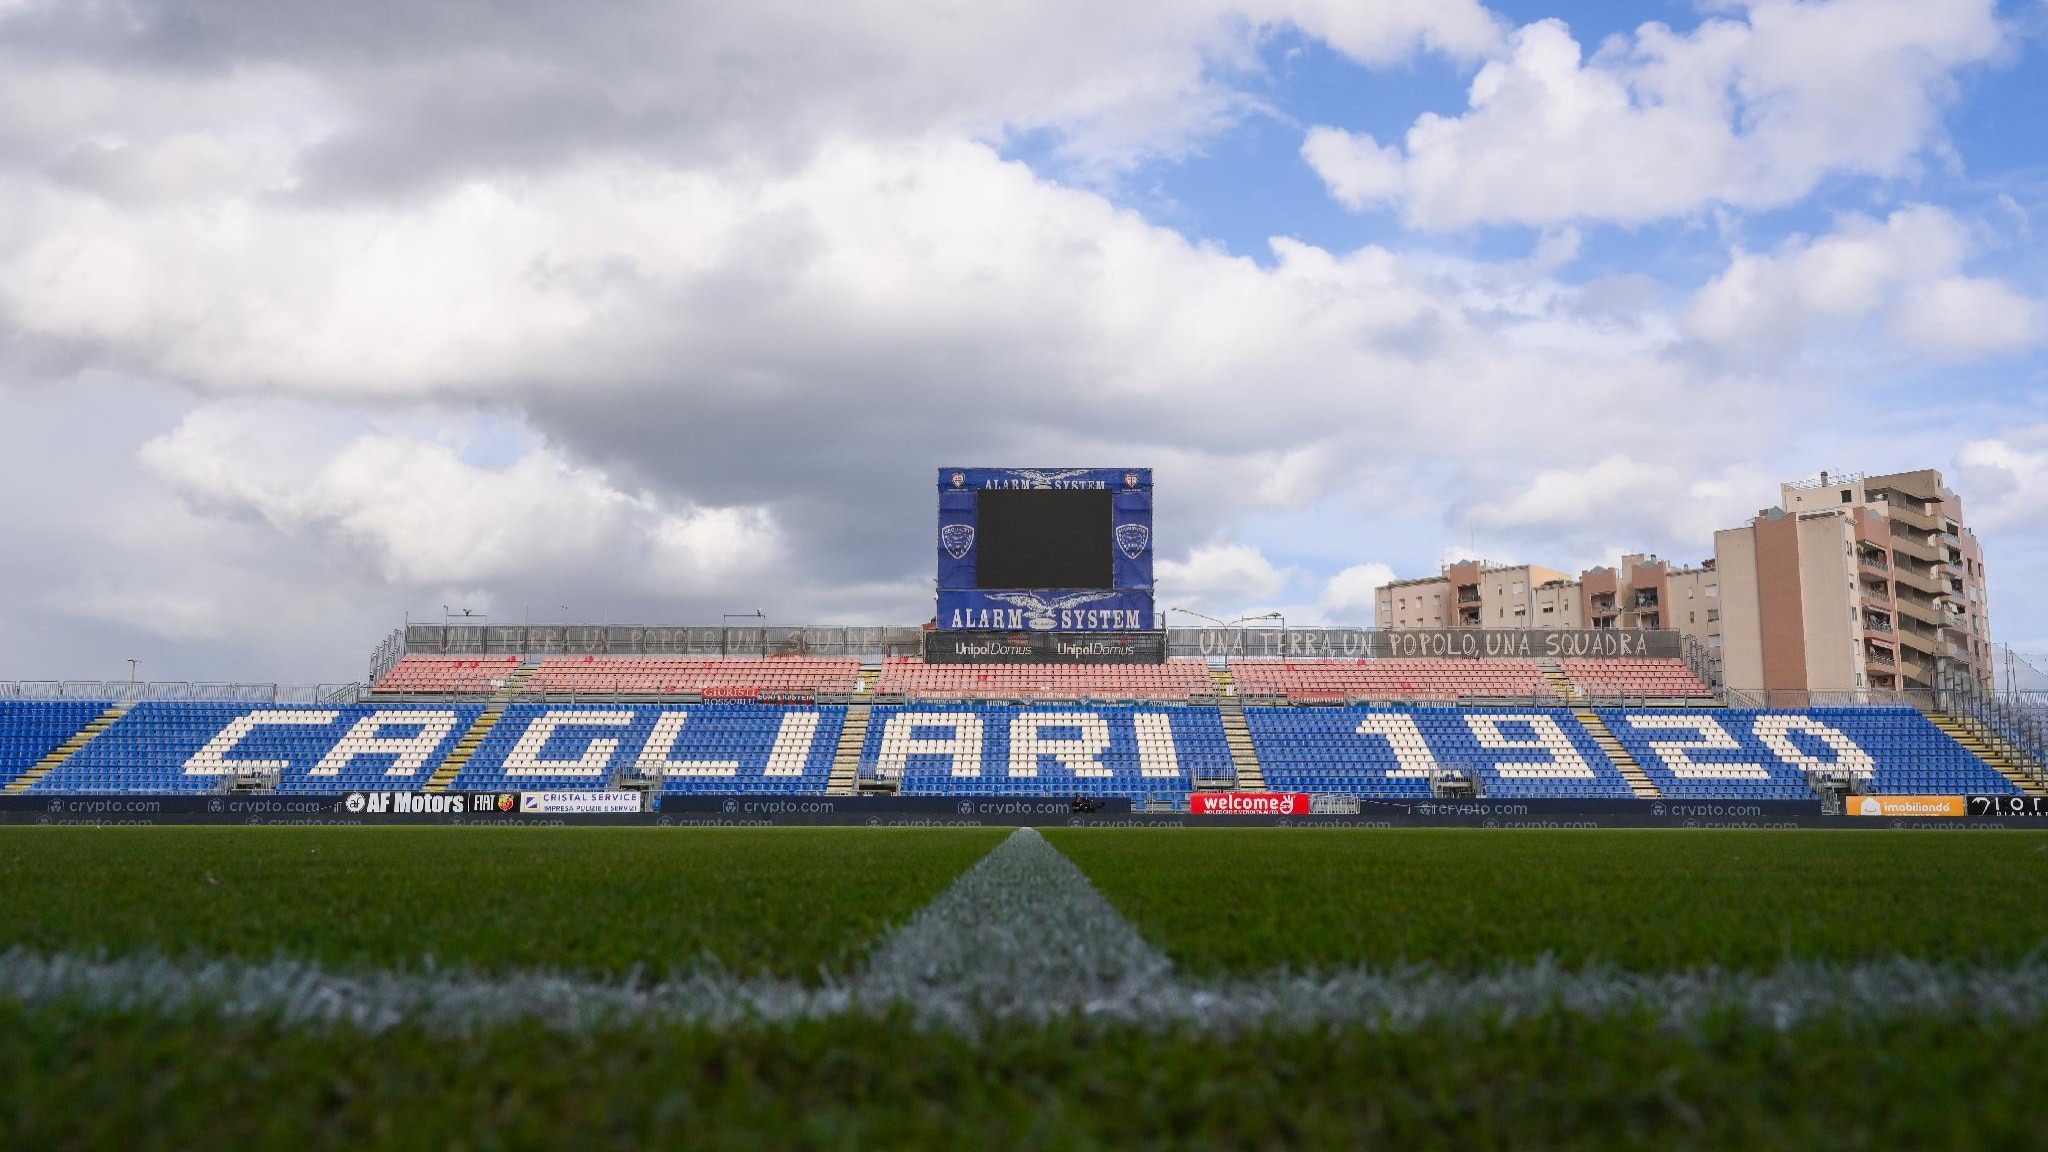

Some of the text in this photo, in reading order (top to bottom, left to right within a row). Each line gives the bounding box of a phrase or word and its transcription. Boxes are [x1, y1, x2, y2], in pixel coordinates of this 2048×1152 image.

[985, 479, 1105, 490] ALARM SYSTEM
[952, 609, 1140, 629] ALARM SYSTEM
[955, 642, 1032, 656] UnipolDomus
[1057, 643, 1135, 656] UnipolDomus
[1199, 632, 1245, 656] UNA
[1343, 632, 1372, 656] UN
[1486, 633, 1531, 656] UNA
[1545, 633, 1648, 656] SQUADRA
[703, 688, 756, 697] GIURISTI
[184, 710, 1876, 779] CAGLIARI 1920
[366, 792, 390, 813] AF
[393, 791, 464, 813] Motors
[473, 793, 496, 812] FIAT
[543, 793, 637, 801] CRISTAL SERVICE
[1203, 794, 1279, 810] welcome
[69, 799, 160, 814] crypto.com
[229, 799, 320, 814] crypto.com
[744, 800, 834, 815] crypto.com
[979, 800, 1070, 815] crypto.com
[1438, 802, 1529, 817] crypto.com
[1672, 802, 1761, 817] crypto.com
